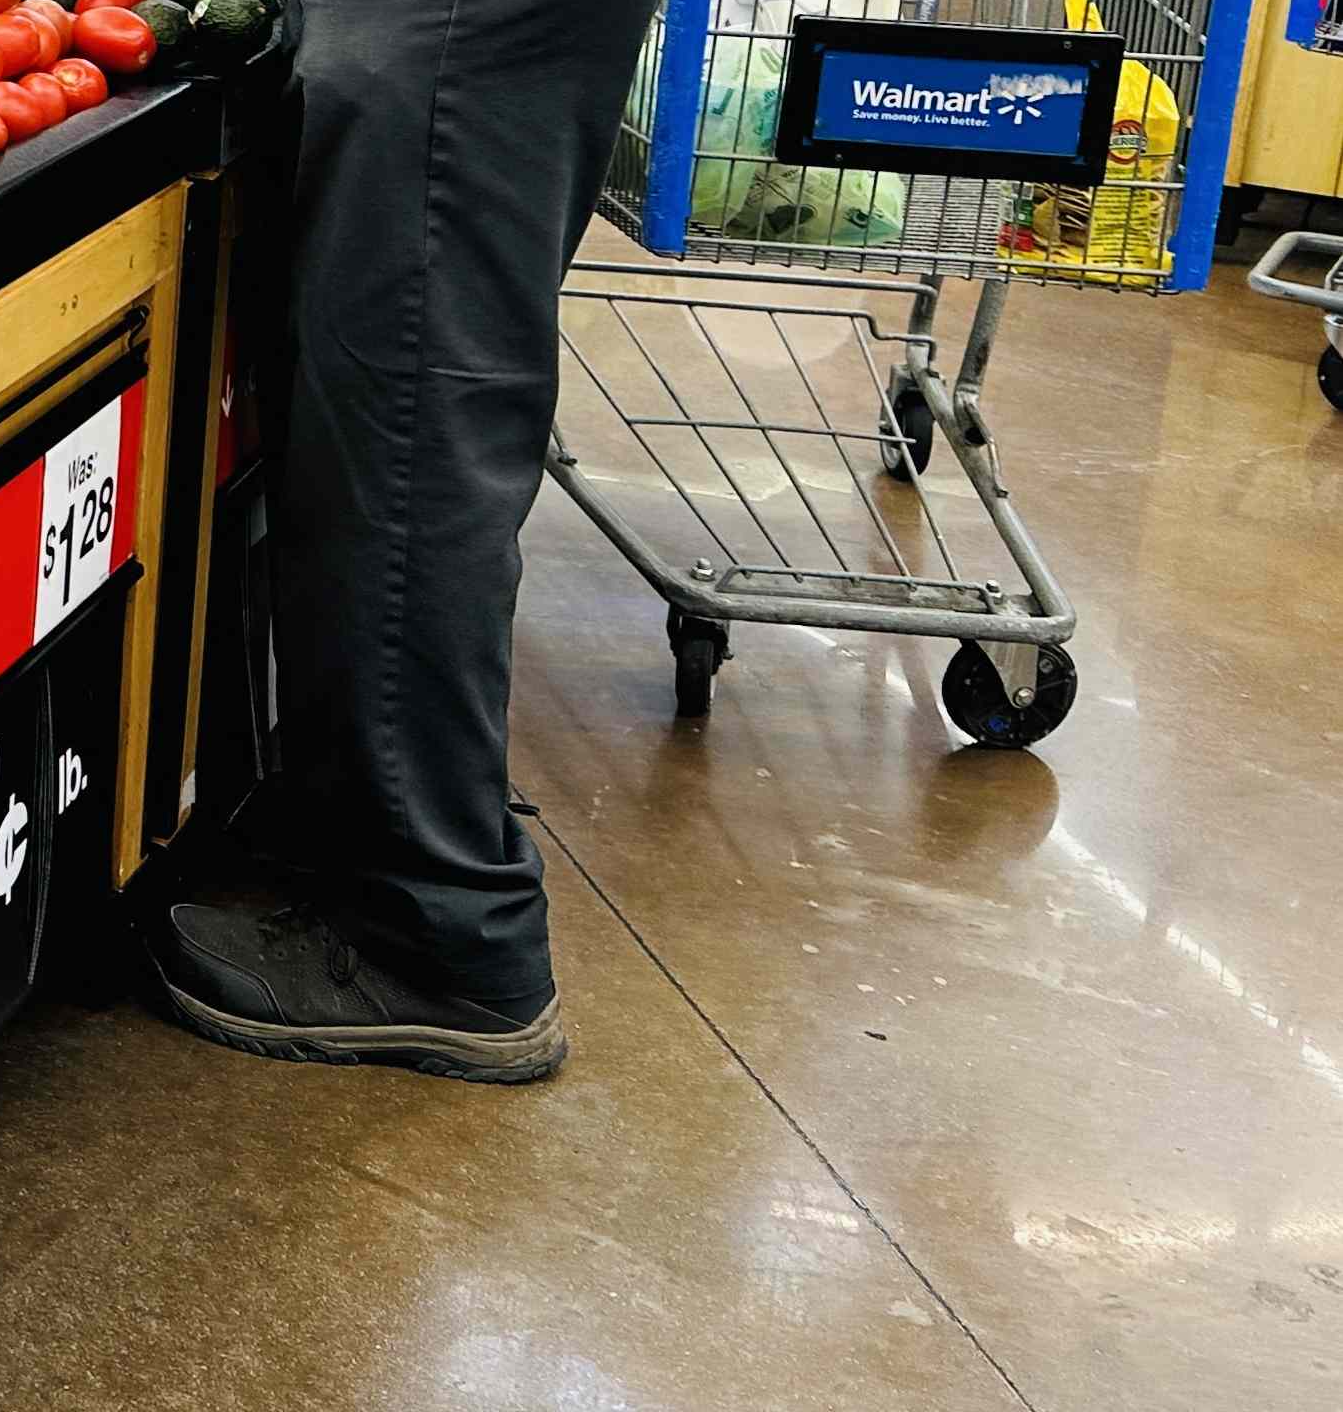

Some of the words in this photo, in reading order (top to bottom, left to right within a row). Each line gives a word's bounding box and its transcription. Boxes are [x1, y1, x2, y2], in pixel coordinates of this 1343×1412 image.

[853, 80, 992, 114] Walmart
[852, 109, 879, 120] Save
[881, 113, 922, 124] money.
[925, 114, 949, 124] Live
[950, 115, 991, 127] better.
[68, 451, 98, 493] Was:
[57, 746, 88, 816] lb.
